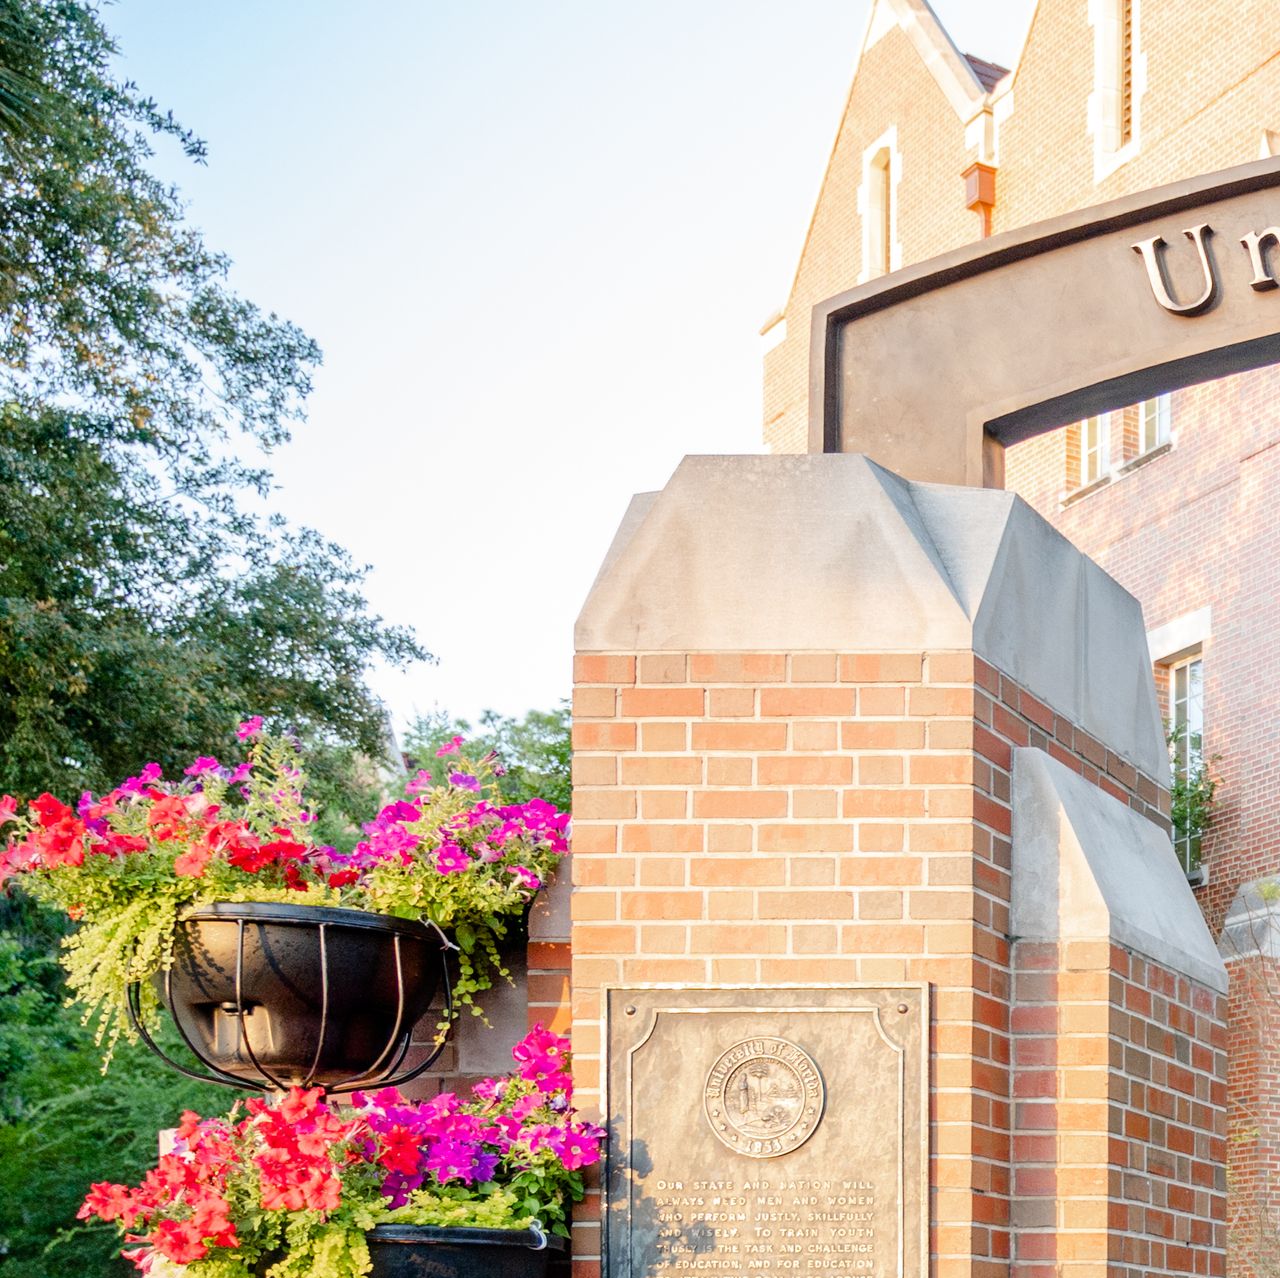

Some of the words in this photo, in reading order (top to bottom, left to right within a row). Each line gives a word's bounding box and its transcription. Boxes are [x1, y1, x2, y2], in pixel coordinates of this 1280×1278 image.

[706, 1041, 765, 1099] University
[770, 1042, 786, 1056] of
[693, 1181, 734, 1190] STATE
[744, 1181, 770, 1190] AND
[779, 1181, 831, 1190] NATION
[842, 1181, 874, 1190] WILL
[656, 1197, 704, 1206] ALWAYS
[712, 1197, 746, 1206] NEED
[757, 1197, 782, 1206] MEN
[792, 1197, 818, 1206] AND
[828, 1197, 874, 1206] WOMEN
[690, 1213, 746, 1222] PERFORM
[808, 1213, 874, 1222] SKILLFULLY
[657, 1228, 682, 1238] AND
[779, 1228, 818, 1238] TRAIN
[830, 1228, 874, 1238] YOUTH
[656, 1244, 697, 1253] THUSLY
[702, 1244, 712, 1253] IS
[718, 1244, 739, 1253] THE
[744, 1244, 773, 1253] TASK
[779, 1244, 802, 1253] AND
[808, 1244, 873, 1253] CHALLENGE
[656, 1260, 670, 1269] OF
[748, 1260, 770, 1269] AND
[777, 1260, 800, 1269] FOR
[808, 1260, 874, 1269] EDUCATION
